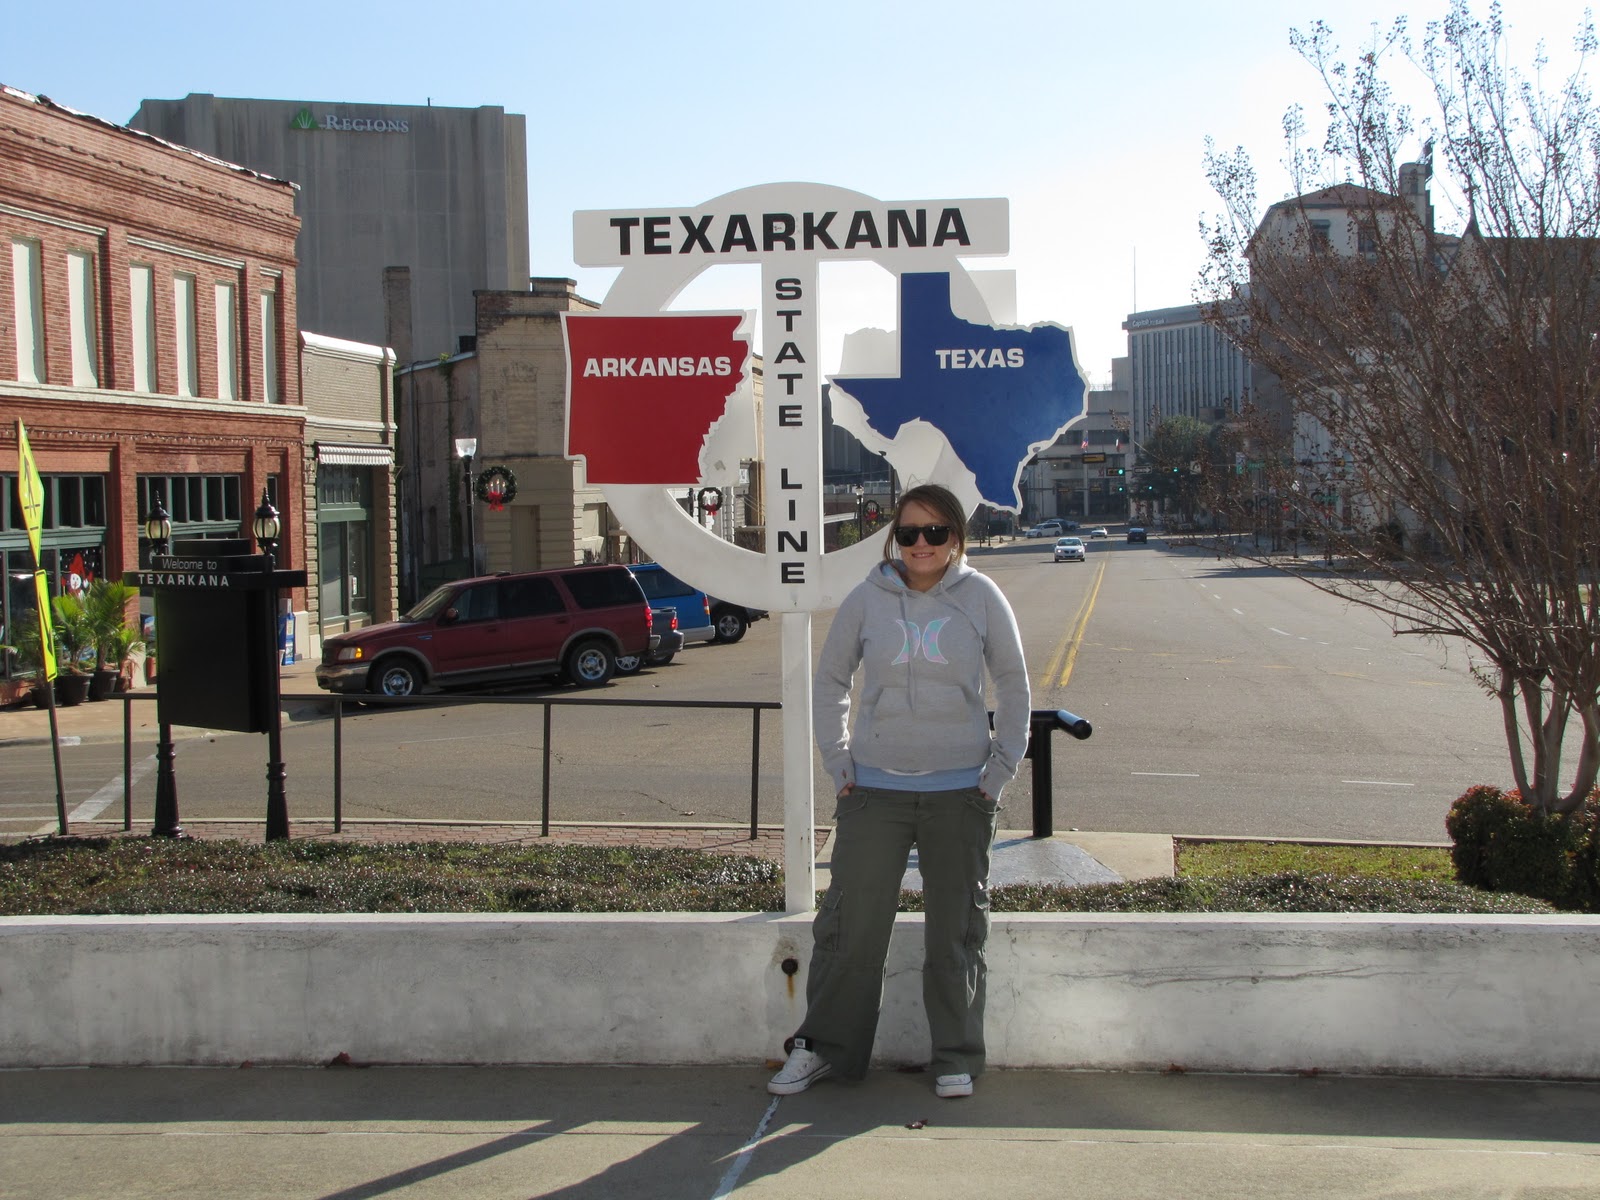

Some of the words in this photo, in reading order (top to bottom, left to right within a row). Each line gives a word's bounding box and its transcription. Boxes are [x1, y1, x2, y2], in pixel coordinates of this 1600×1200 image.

[325, 114, 409, 133] REGIONS
[609, 207, 971, 256] TEXARKANA
[774, 278, 806, 427] STATE
[935, 347, 1025, 370] TEXAS
[583, 356, 732, 378] ARKANSAS
[777, 468, 808, 584] LINE
[162, 558, 203, 570] Welcome
[207, 560, 218, 570] to
[138, 573, 230, 587] TEXARKANA
